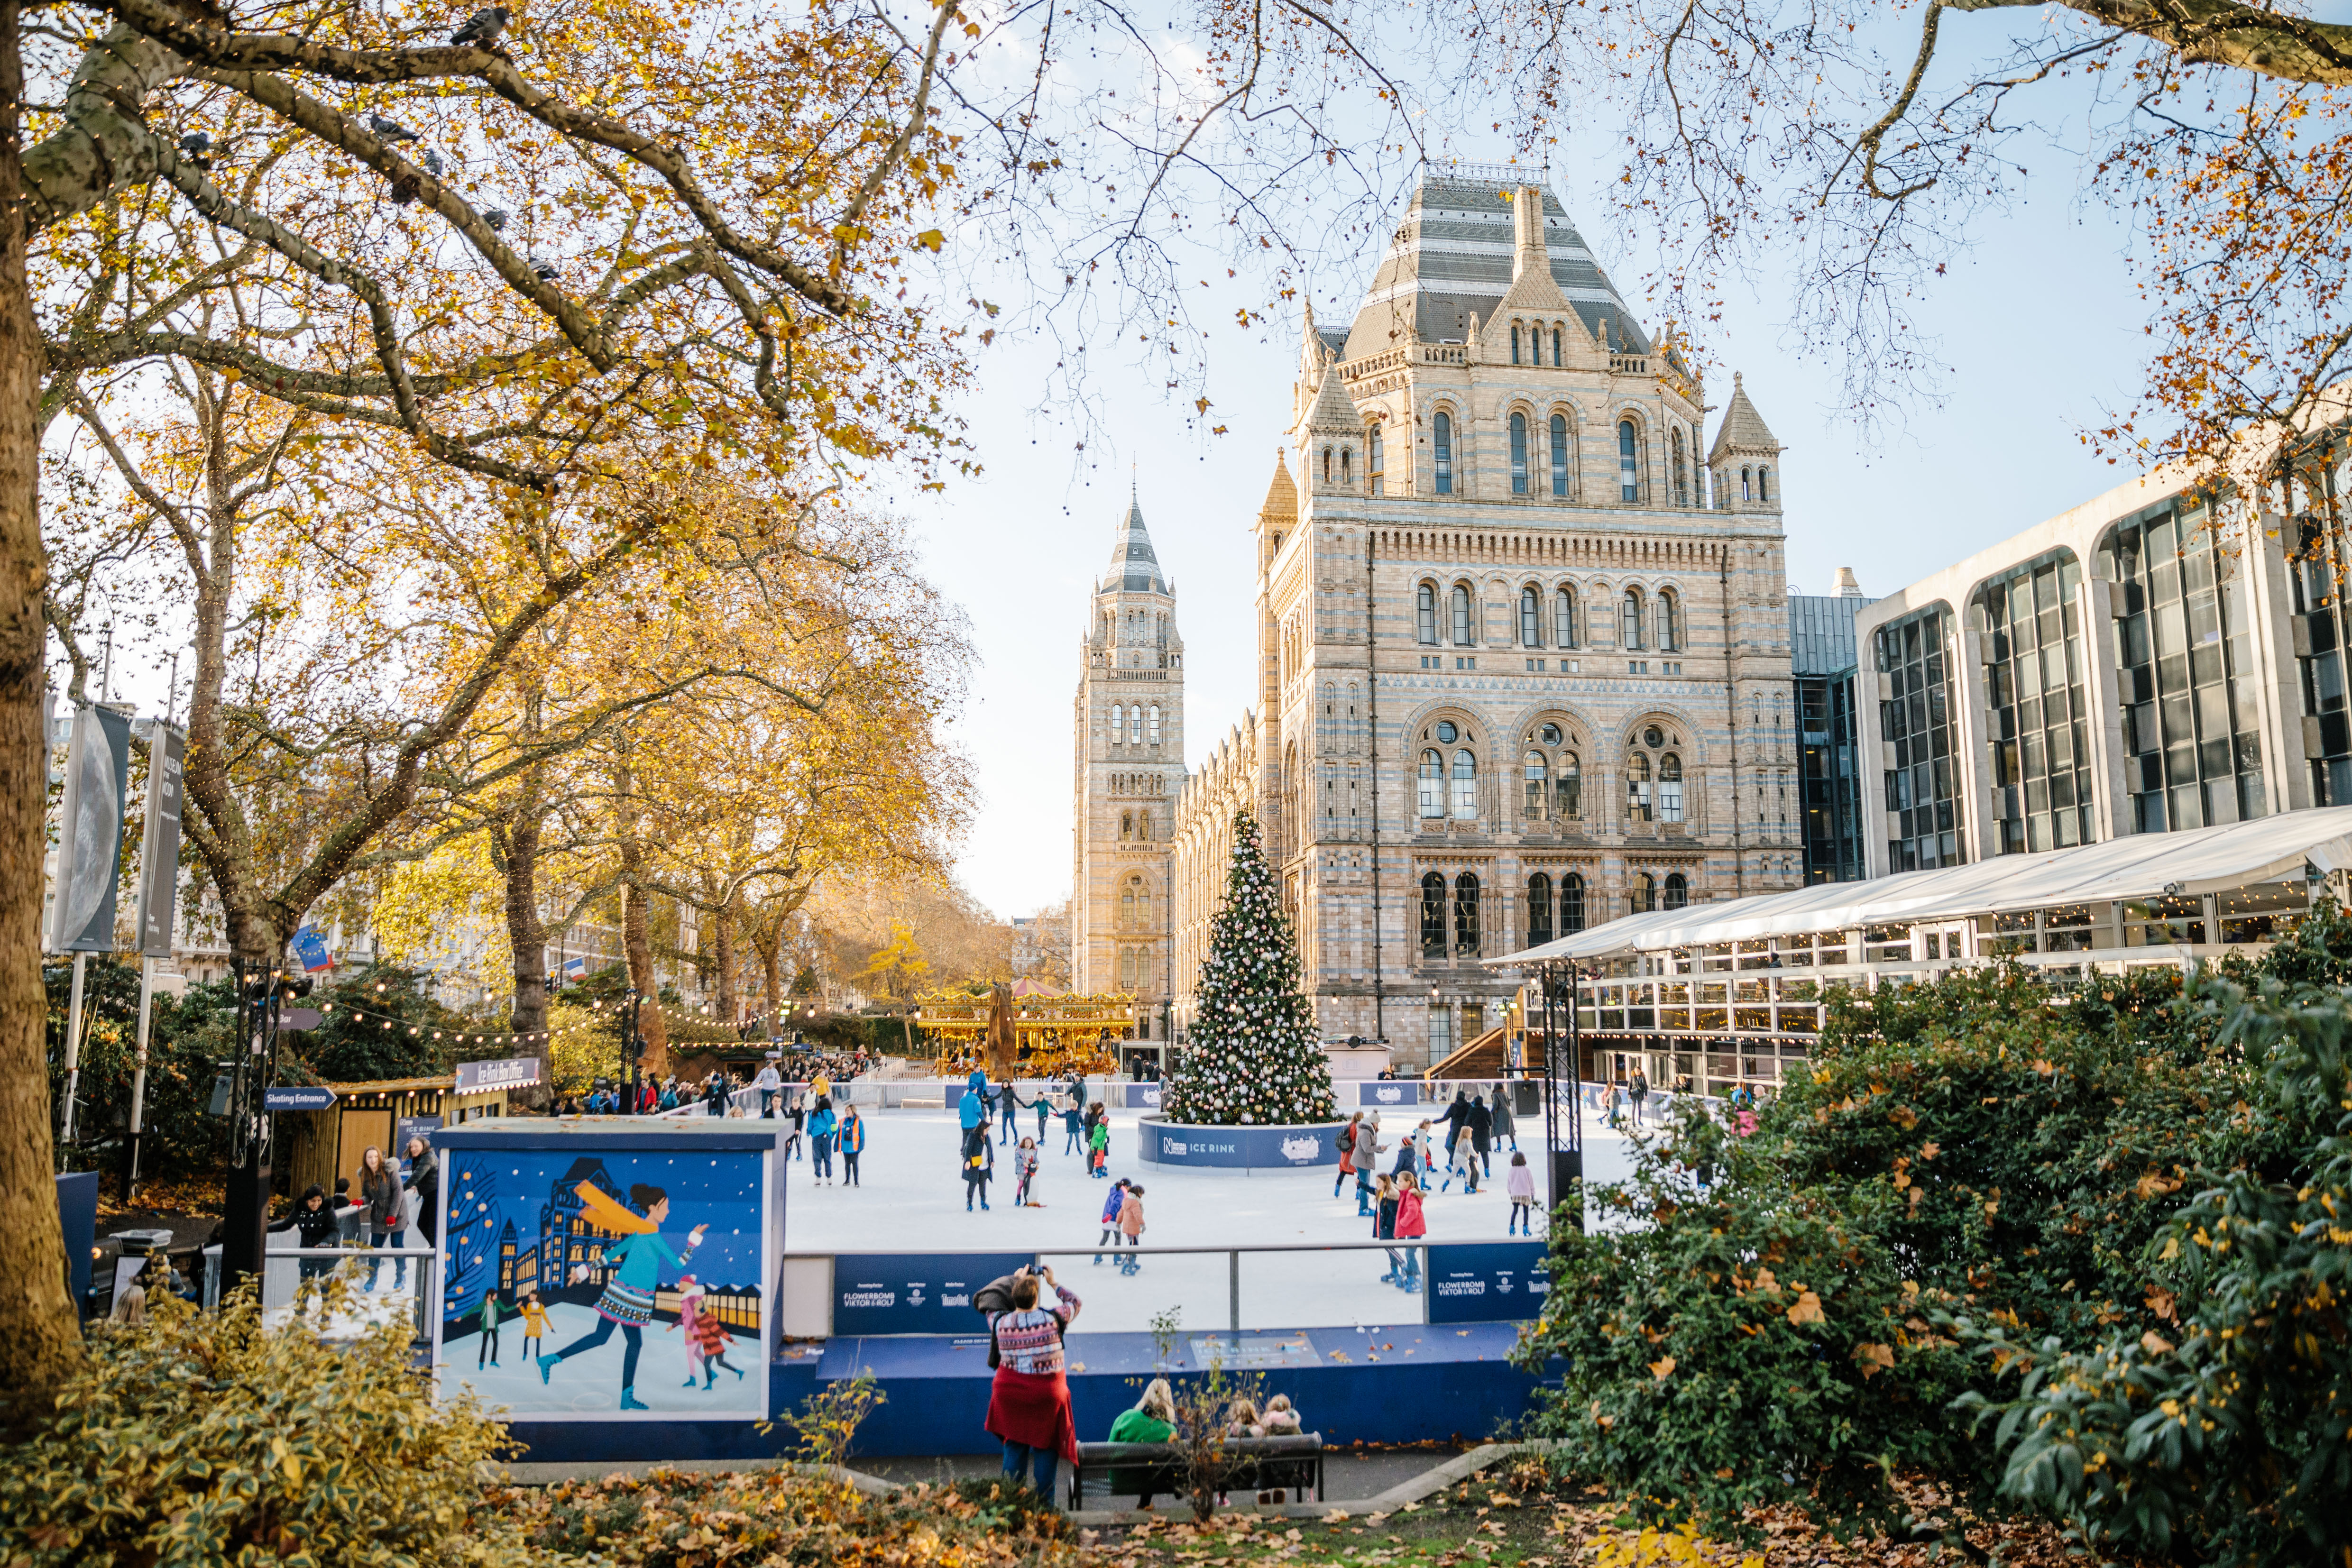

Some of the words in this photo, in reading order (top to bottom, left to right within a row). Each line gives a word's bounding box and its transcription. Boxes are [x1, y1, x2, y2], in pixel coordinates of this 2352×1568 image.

[478, 1064, 487, 1083] Ice
[487, 1063, 498, 1082] Rink
[499, 1062, 509, 1080] Box
[509, 1061, 523, 1080] Office
[267, 1094, 294, 1105] Skating
[294, 1094, 327, 1103] Entrance
[1190, 1143, 1205, 1152] ICE
[1210, 1144, 1235, 1153] RINK
[845, 1299, 870, 1307] VIKTOR
